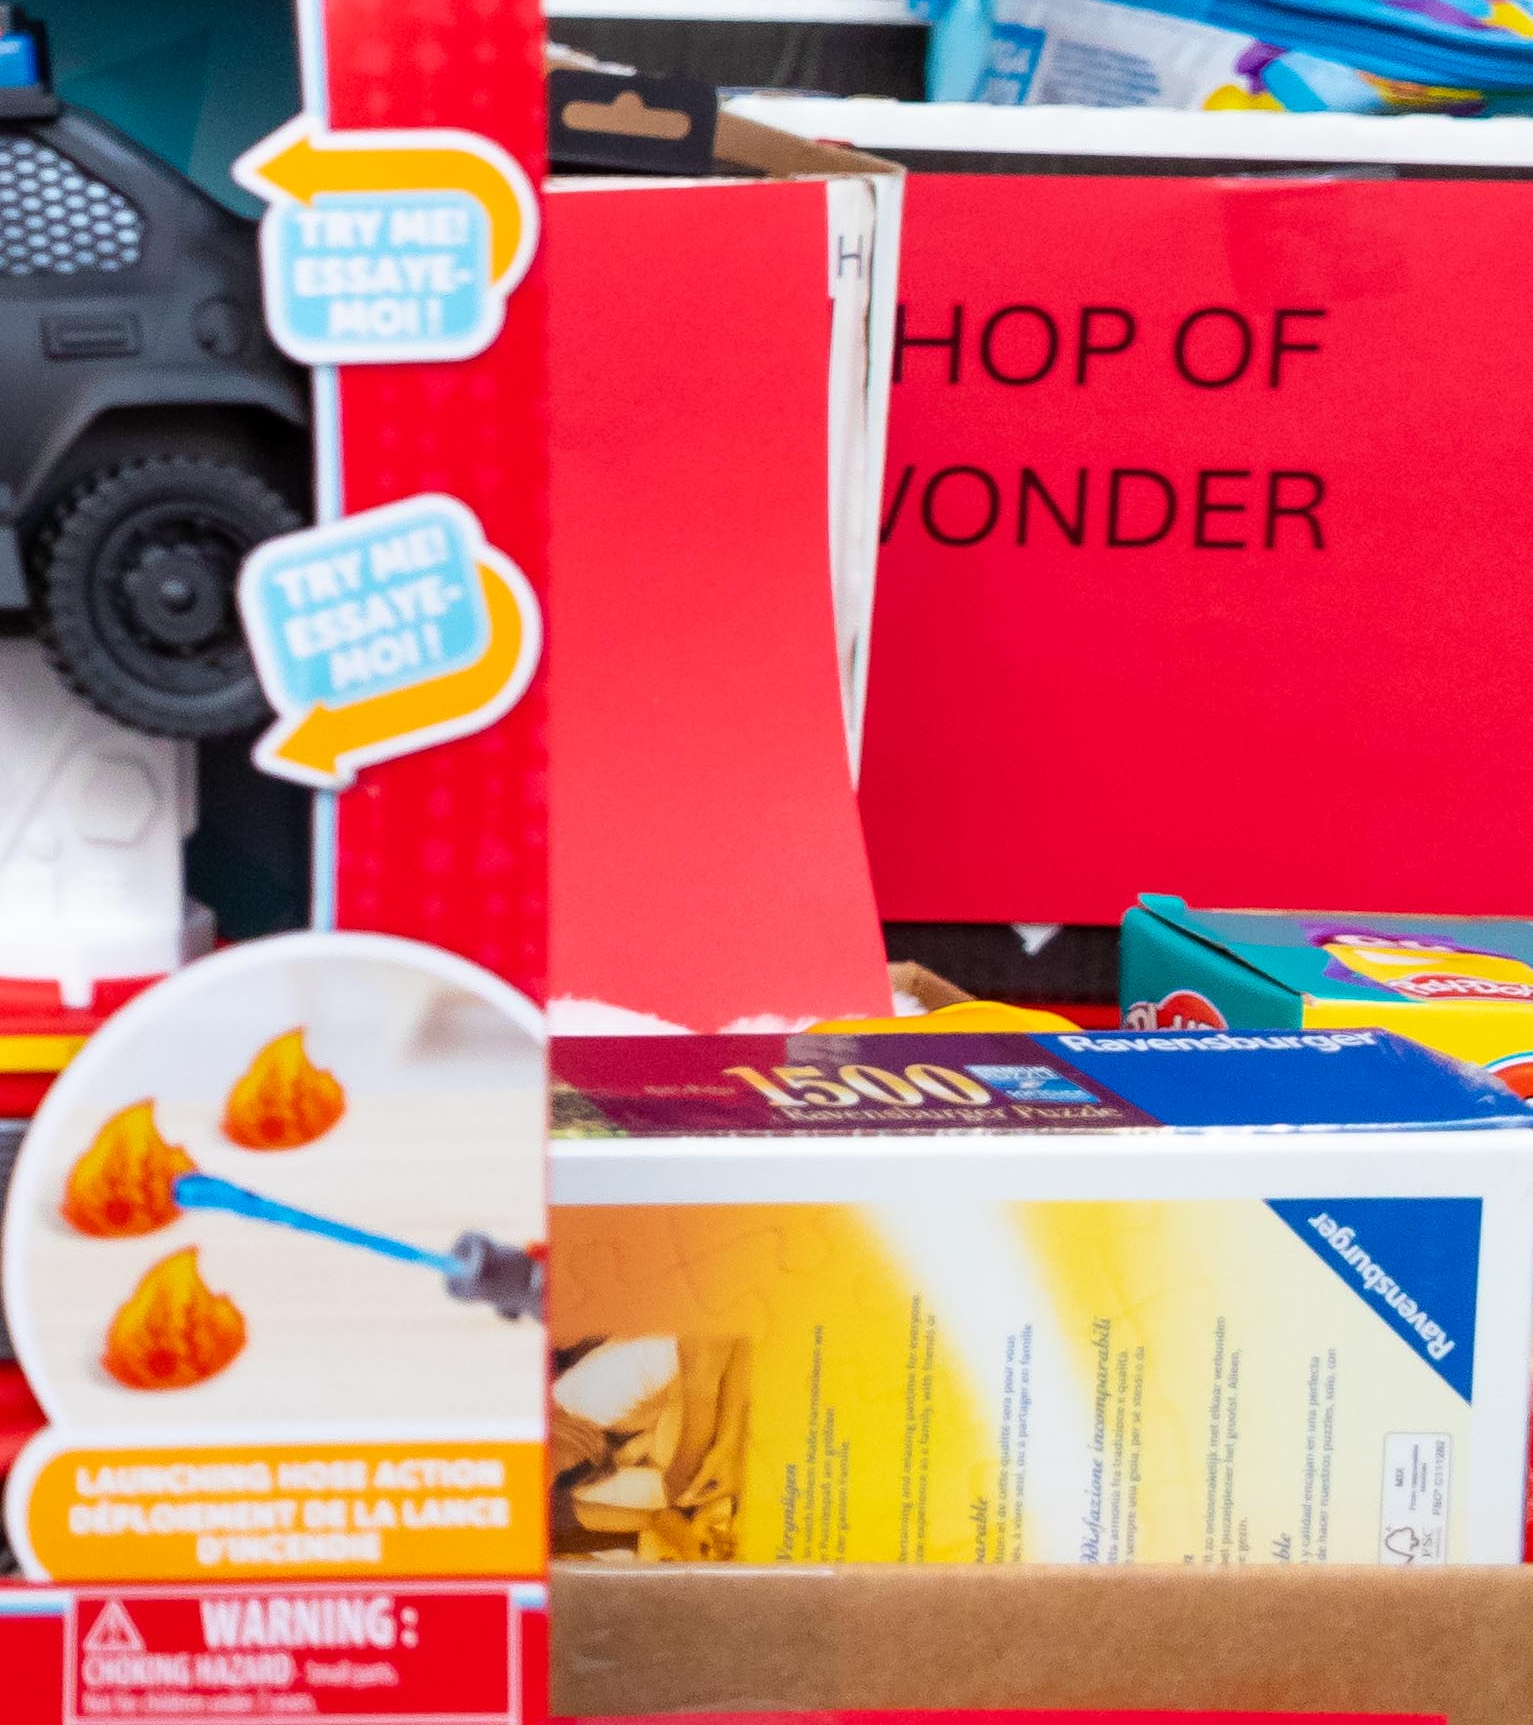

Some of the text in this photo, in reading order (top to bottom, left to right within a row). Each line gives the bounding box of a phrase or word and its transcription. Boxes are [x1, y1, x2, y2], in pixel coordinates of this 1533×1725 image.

[292, 206, 470, 252] TRY ME!
[292, 255, 471, 299] ESSAYE-
[1172, 304, 1328, 389] OF
[273, 525, 450, 613] TRY ME!
[285, 578, 465, 655] ESSAYE-
[1057, 1029, 1380, 1054] Ravensburger
[721, 1063, 992, 1107] 1500
[785, 1103, 1125, 1121] Ravensburger Puzzle
[1307, 1211, 1456, 1360] Ravensburger
[1006, 1335, 1015, 1363] vous
[1211, 1317, 1226, 1379] verbonden
[1004, 1366, 1015, 1393] pour
[1307, 1357, 1322, 1405] perfecta
[1018, 1387, 1032, 1437] partager
[1209, 1385, 1222, 1419] elkaar
[1112, 1408, 1126, 1467] tradizione
[1208, 1425, 1220, 1447] met
[1320, 1455, 1332, 1506] nuestros
[1326, 1349, 1336, 1369] con
[75, 1458, 504, 1497] LAUNCHING HOSE ACTION
[302, 1498, 345, 1529] DE
[353, 1498, 396, 1529] LA
[401, 1496, 509, 1528] LANCE
[1128, 1511, 1138, 1555] sempre
[82, 1653, 191, 1688] CHOKING
[195, 1652, 295, 1687] HAZARD
